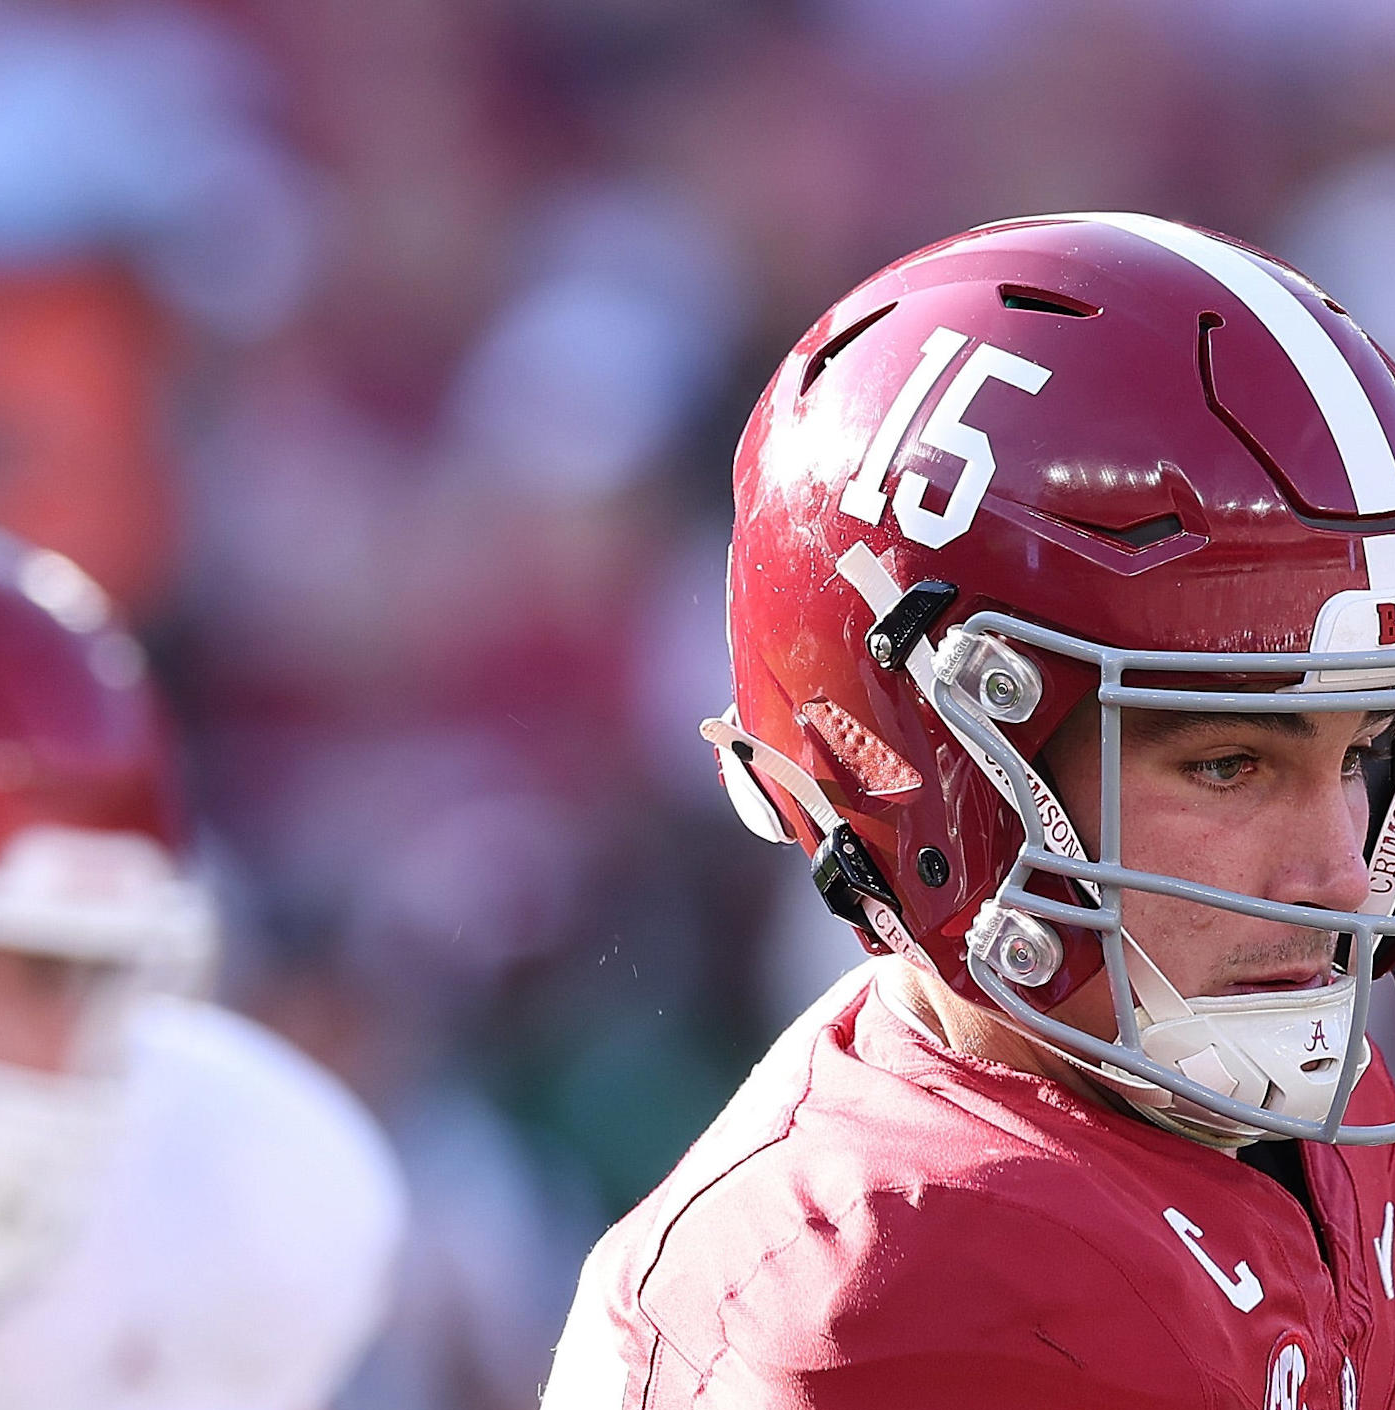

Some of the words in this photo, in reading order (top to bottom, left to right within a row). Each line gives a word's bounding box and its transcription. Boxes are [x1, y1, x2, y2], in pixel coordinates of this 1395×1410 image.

[838, 327, 1053, 549] 15
[1304, 1018, 1329, 1053] A
[1163, 1206, 1265, 1314] C
